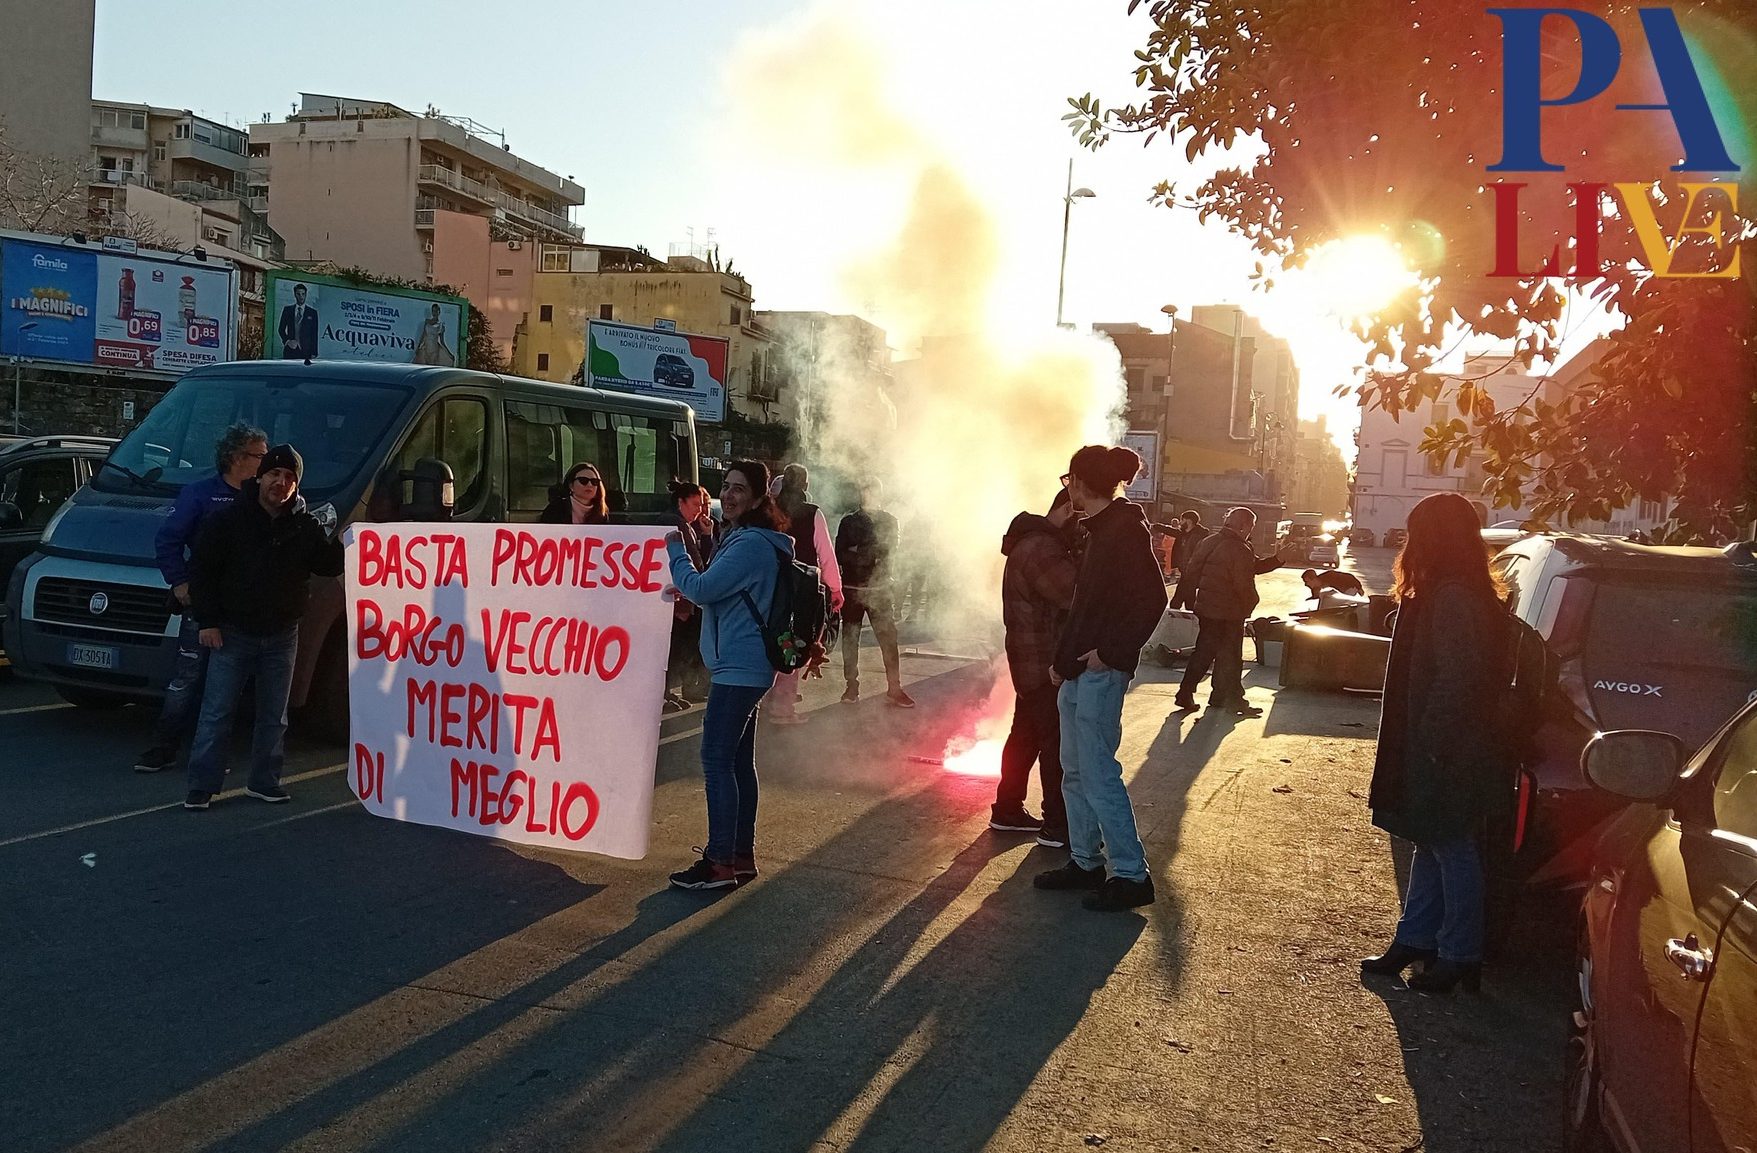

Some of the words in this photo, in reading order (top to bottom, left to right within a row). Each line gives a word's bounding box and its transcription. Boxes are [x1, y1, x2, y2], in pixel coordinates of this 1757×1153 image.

[32, 254, 68, 269] famila
[20, 297, 88, 317] MAGNIFICI
[340, 301, 365, 313] SPOSI
[376, 306, 400, 318] FIERA
[129, 317, 159, 336] 0,69
[188, 325, 216, 341] 0,85
[321, 323, 415, 351] Acquaviva
[100, 350, 137, 360] CONTINUA
[162, 349, 188, 358] SPESA
[189, 352, 217, 362] DIFESA
[358, 529, 468, 590] BASTA
[491, 528, 667, 593] PROMESSE
[356, 599, 465, 668] BORGO
[481, 608, 631, 682] VECCHIO
[406, 677, 561, 763] MERITA
[355, 743, 385, 804] DI
[450, 757, 601, 841] MEGLIO
